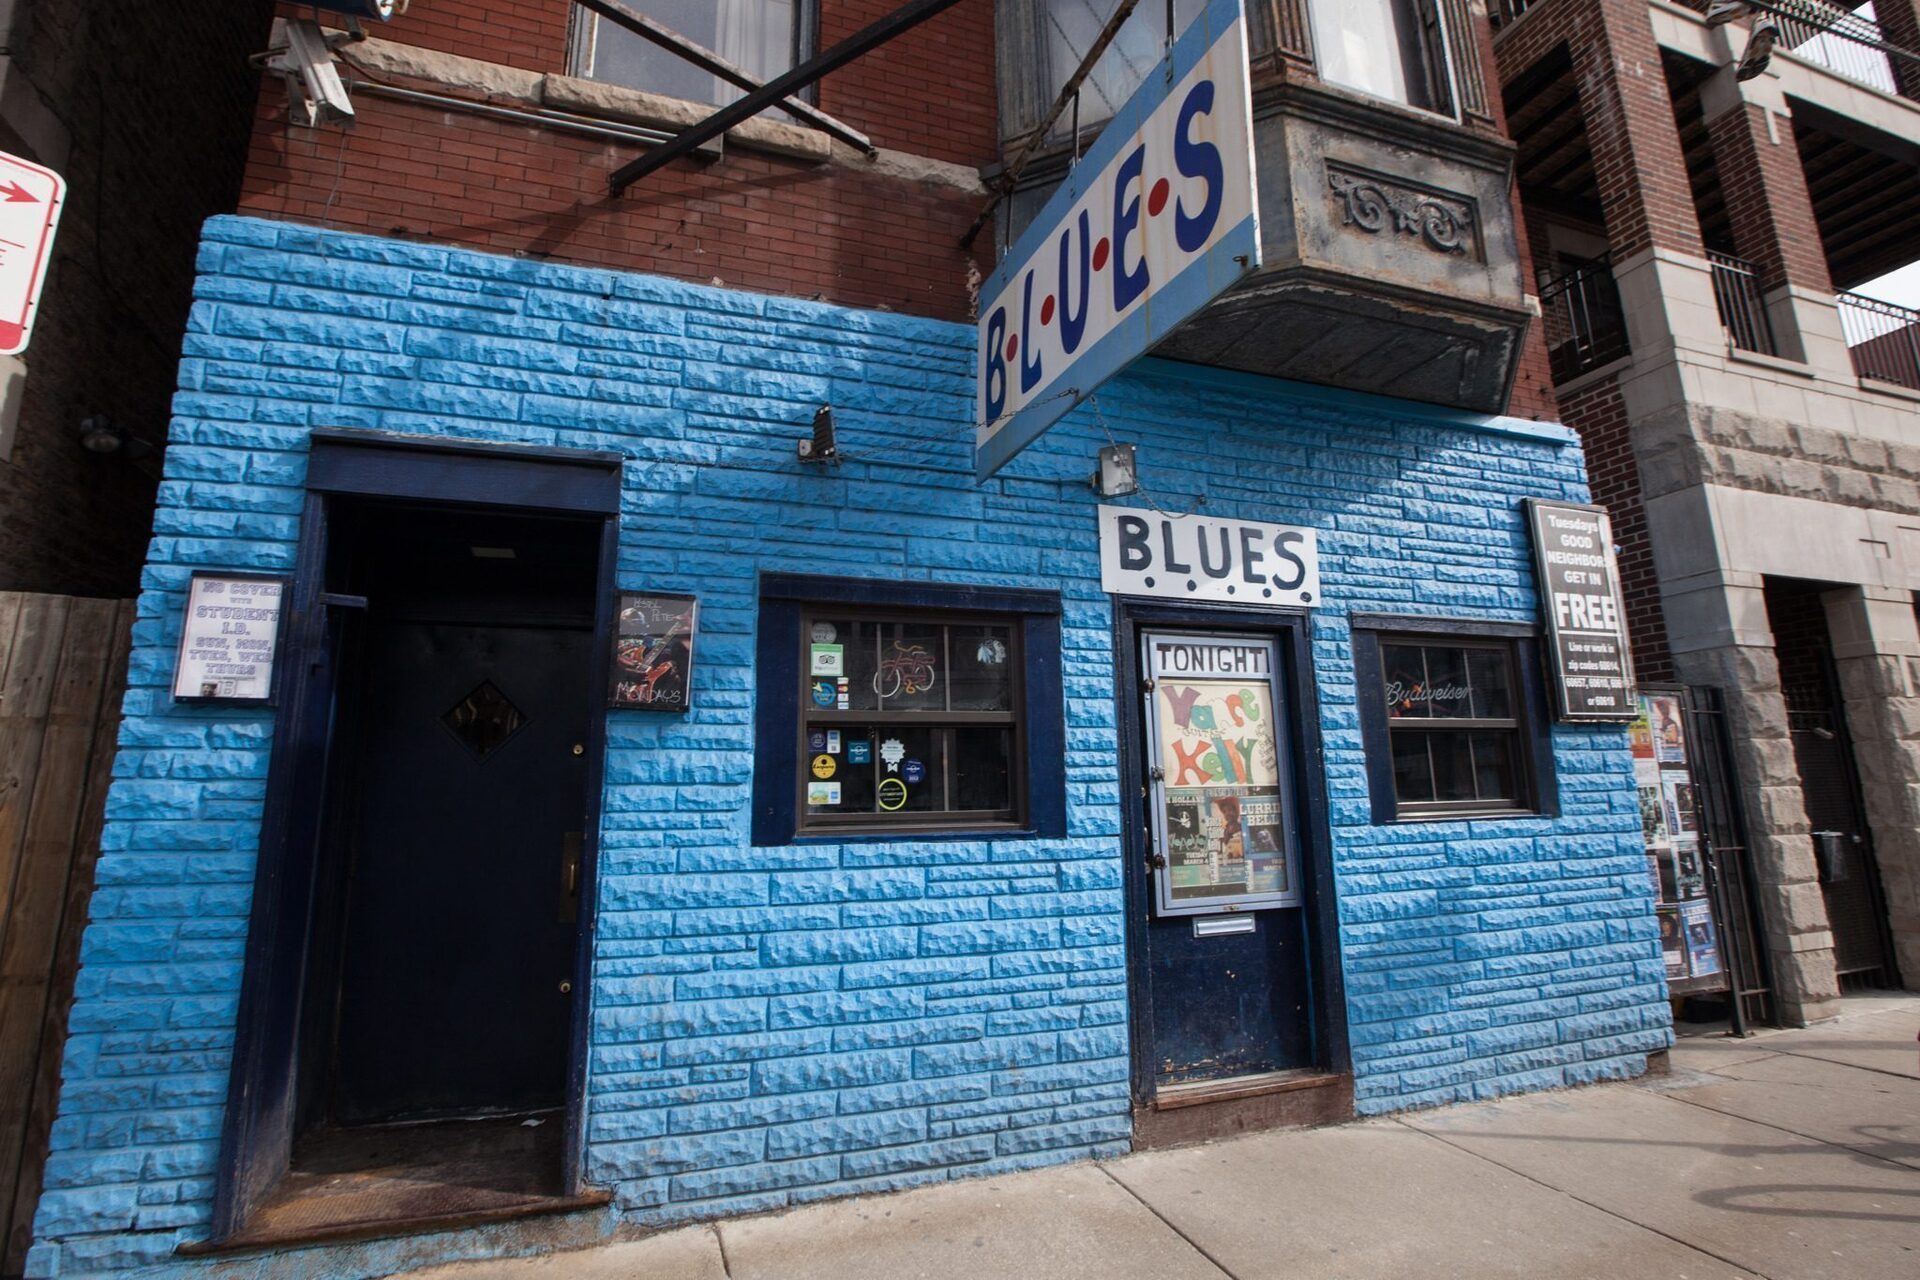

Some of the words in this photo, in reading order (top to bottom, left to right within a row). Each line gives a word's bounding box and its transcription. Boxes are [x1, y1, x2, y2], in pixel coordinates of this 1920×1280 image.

[1548, 515, 1599, 534] Tuesdays
[1560, 534, 1593, 549] GOOD
[1564, 570, 1586, 585] GET
[1589, 572, 1602, 586] IN
[202, 581, 225, 594] NO
[230, 583, 280, 597] COVER
[196, 605, 280, 621] STUDENT
[1554, 592, 1617, 630] FREE
[222, 622, 251, 636] I.D.
[1568, 642, 1583, 652] Live
[1592, 643, 1607, 653] work
[1608, 644, 1615, 653] in
[1157, 643, 1264, 673] TONIGHT
[1568, 660, 1578, 671] zip
[1580, 660, 1598, 670] codes
[205, 663, 256, 676] THURS
[1386, 681, 1473, 706] Budweiser
[1587, 698, 1595, 706] or
[1247, 814, 1280, 826] BELL
